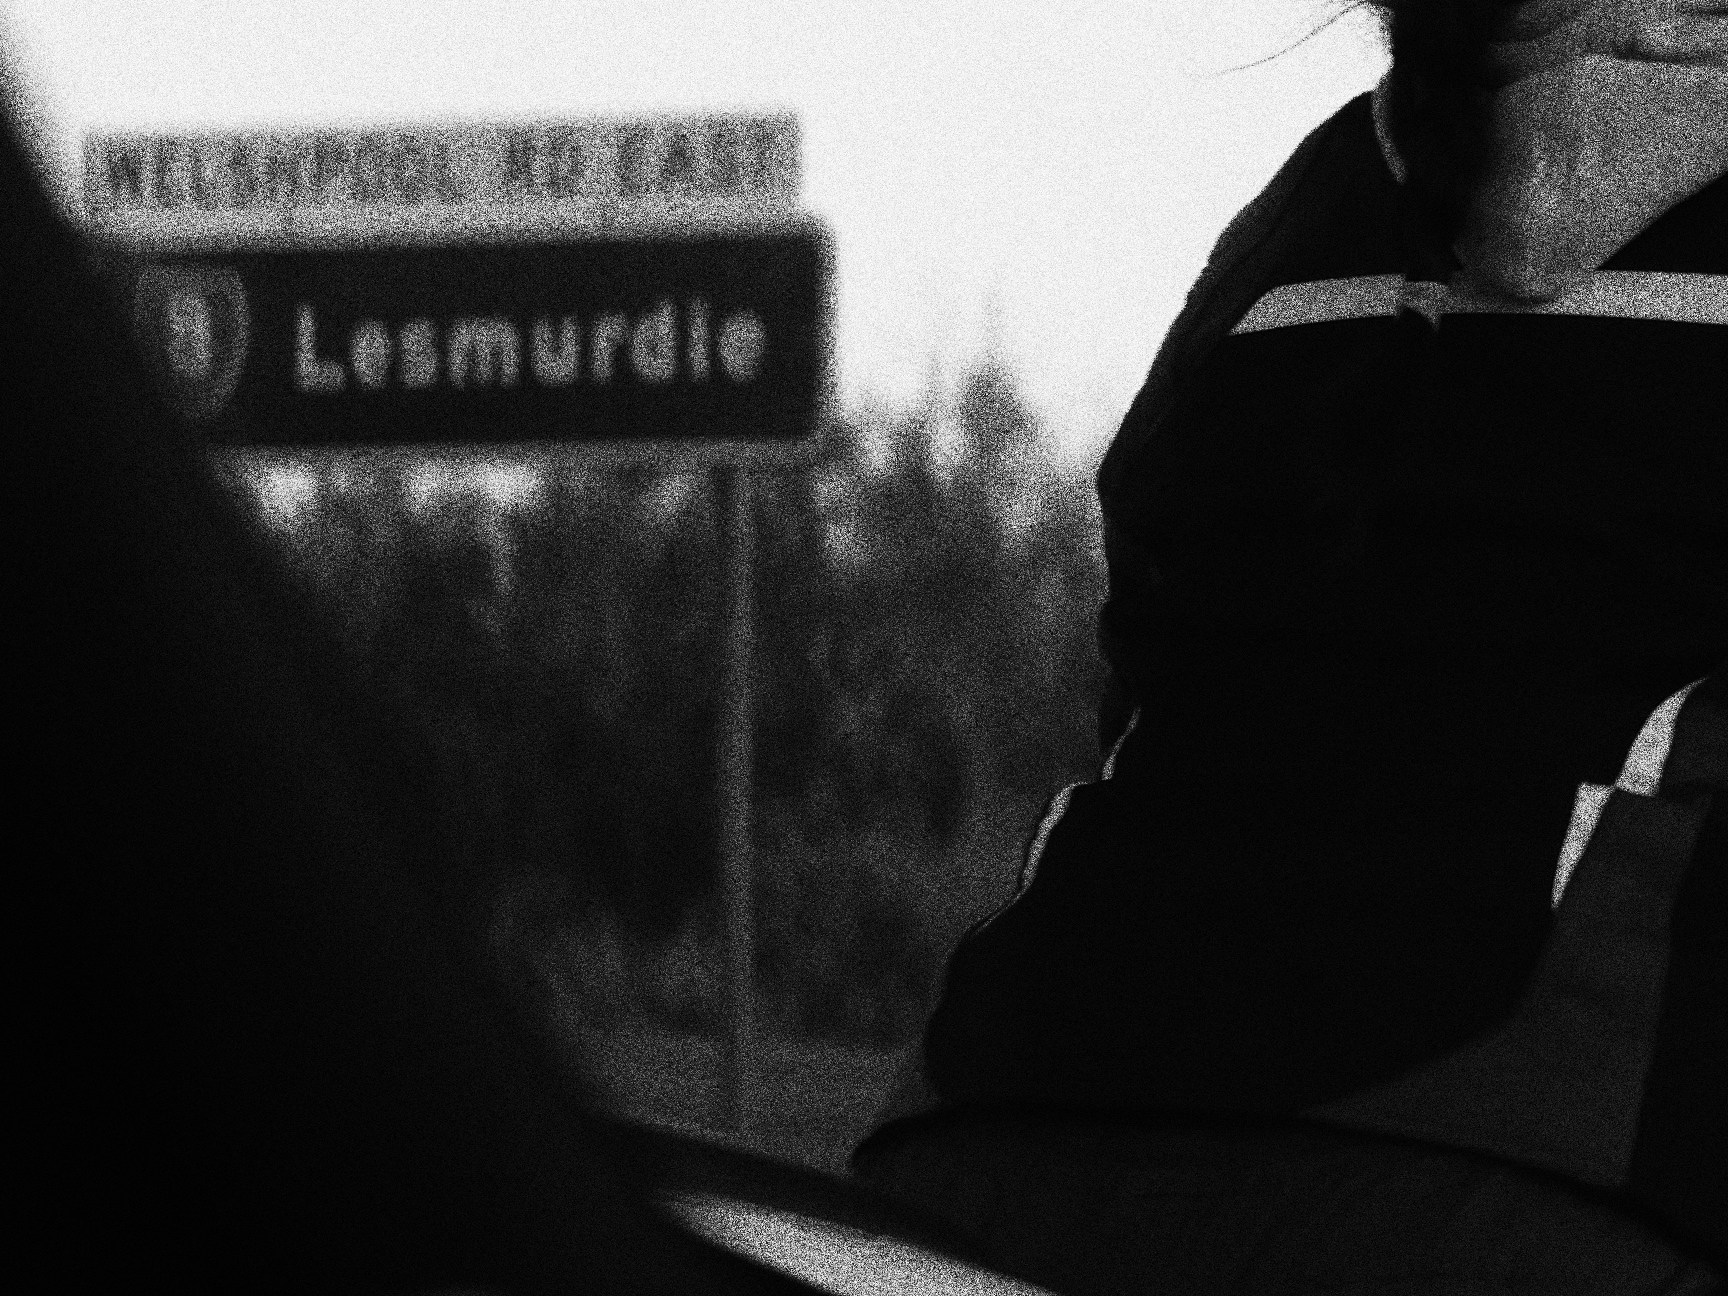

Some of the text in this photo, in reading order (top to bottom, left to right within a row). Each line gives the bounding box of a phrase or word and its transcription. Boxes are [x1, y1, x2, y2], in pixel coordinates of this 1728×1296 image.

[106, 118, 777, 208] WELSHPOOL RD EAST
[295, 296, 767, 393] Lesmurdie
